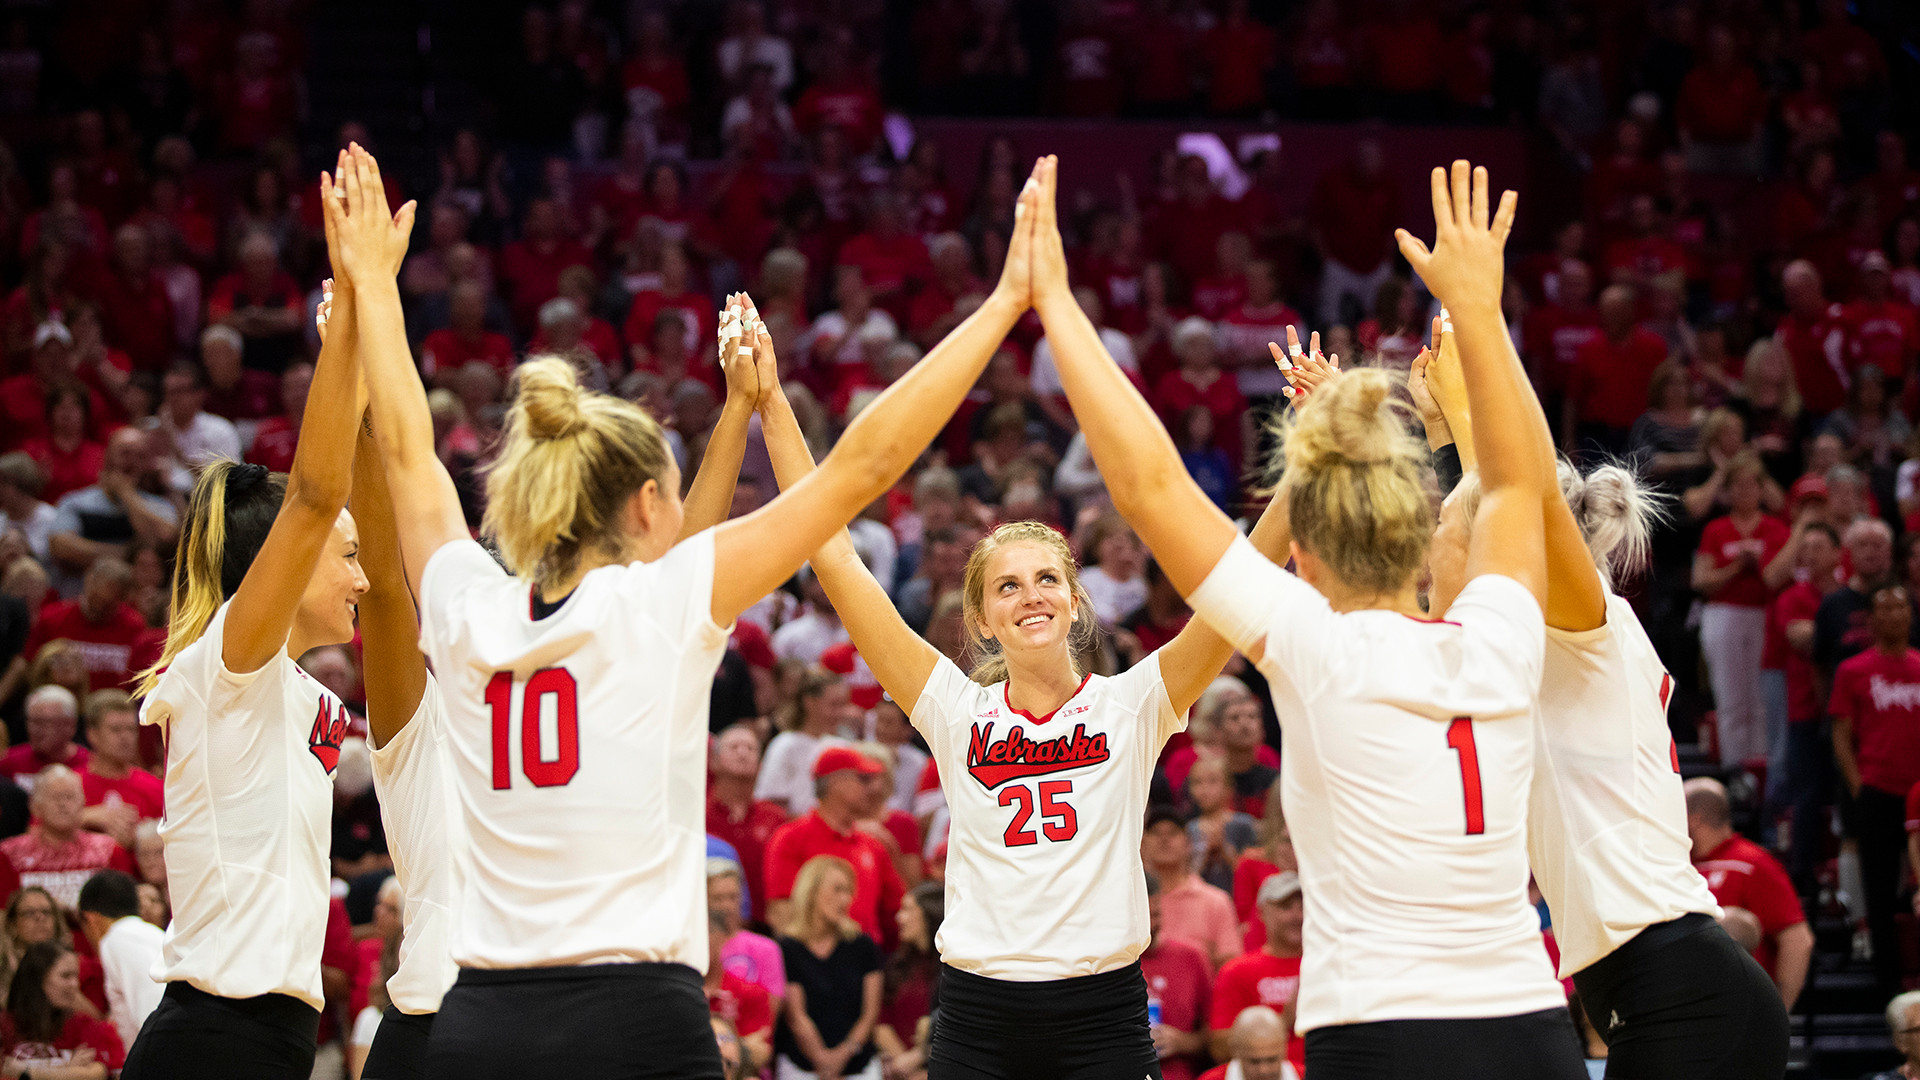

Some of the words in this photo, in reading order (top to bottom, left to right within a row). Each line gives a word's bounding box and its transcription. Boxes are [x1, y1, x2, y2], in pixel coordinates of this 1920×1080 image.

[485, 667, 579, 790] 10
[967, 721, 1110, 768] Nebraska
[998, 780, 1078, 847] 25
[1446, 716, 1485, 835] 1
